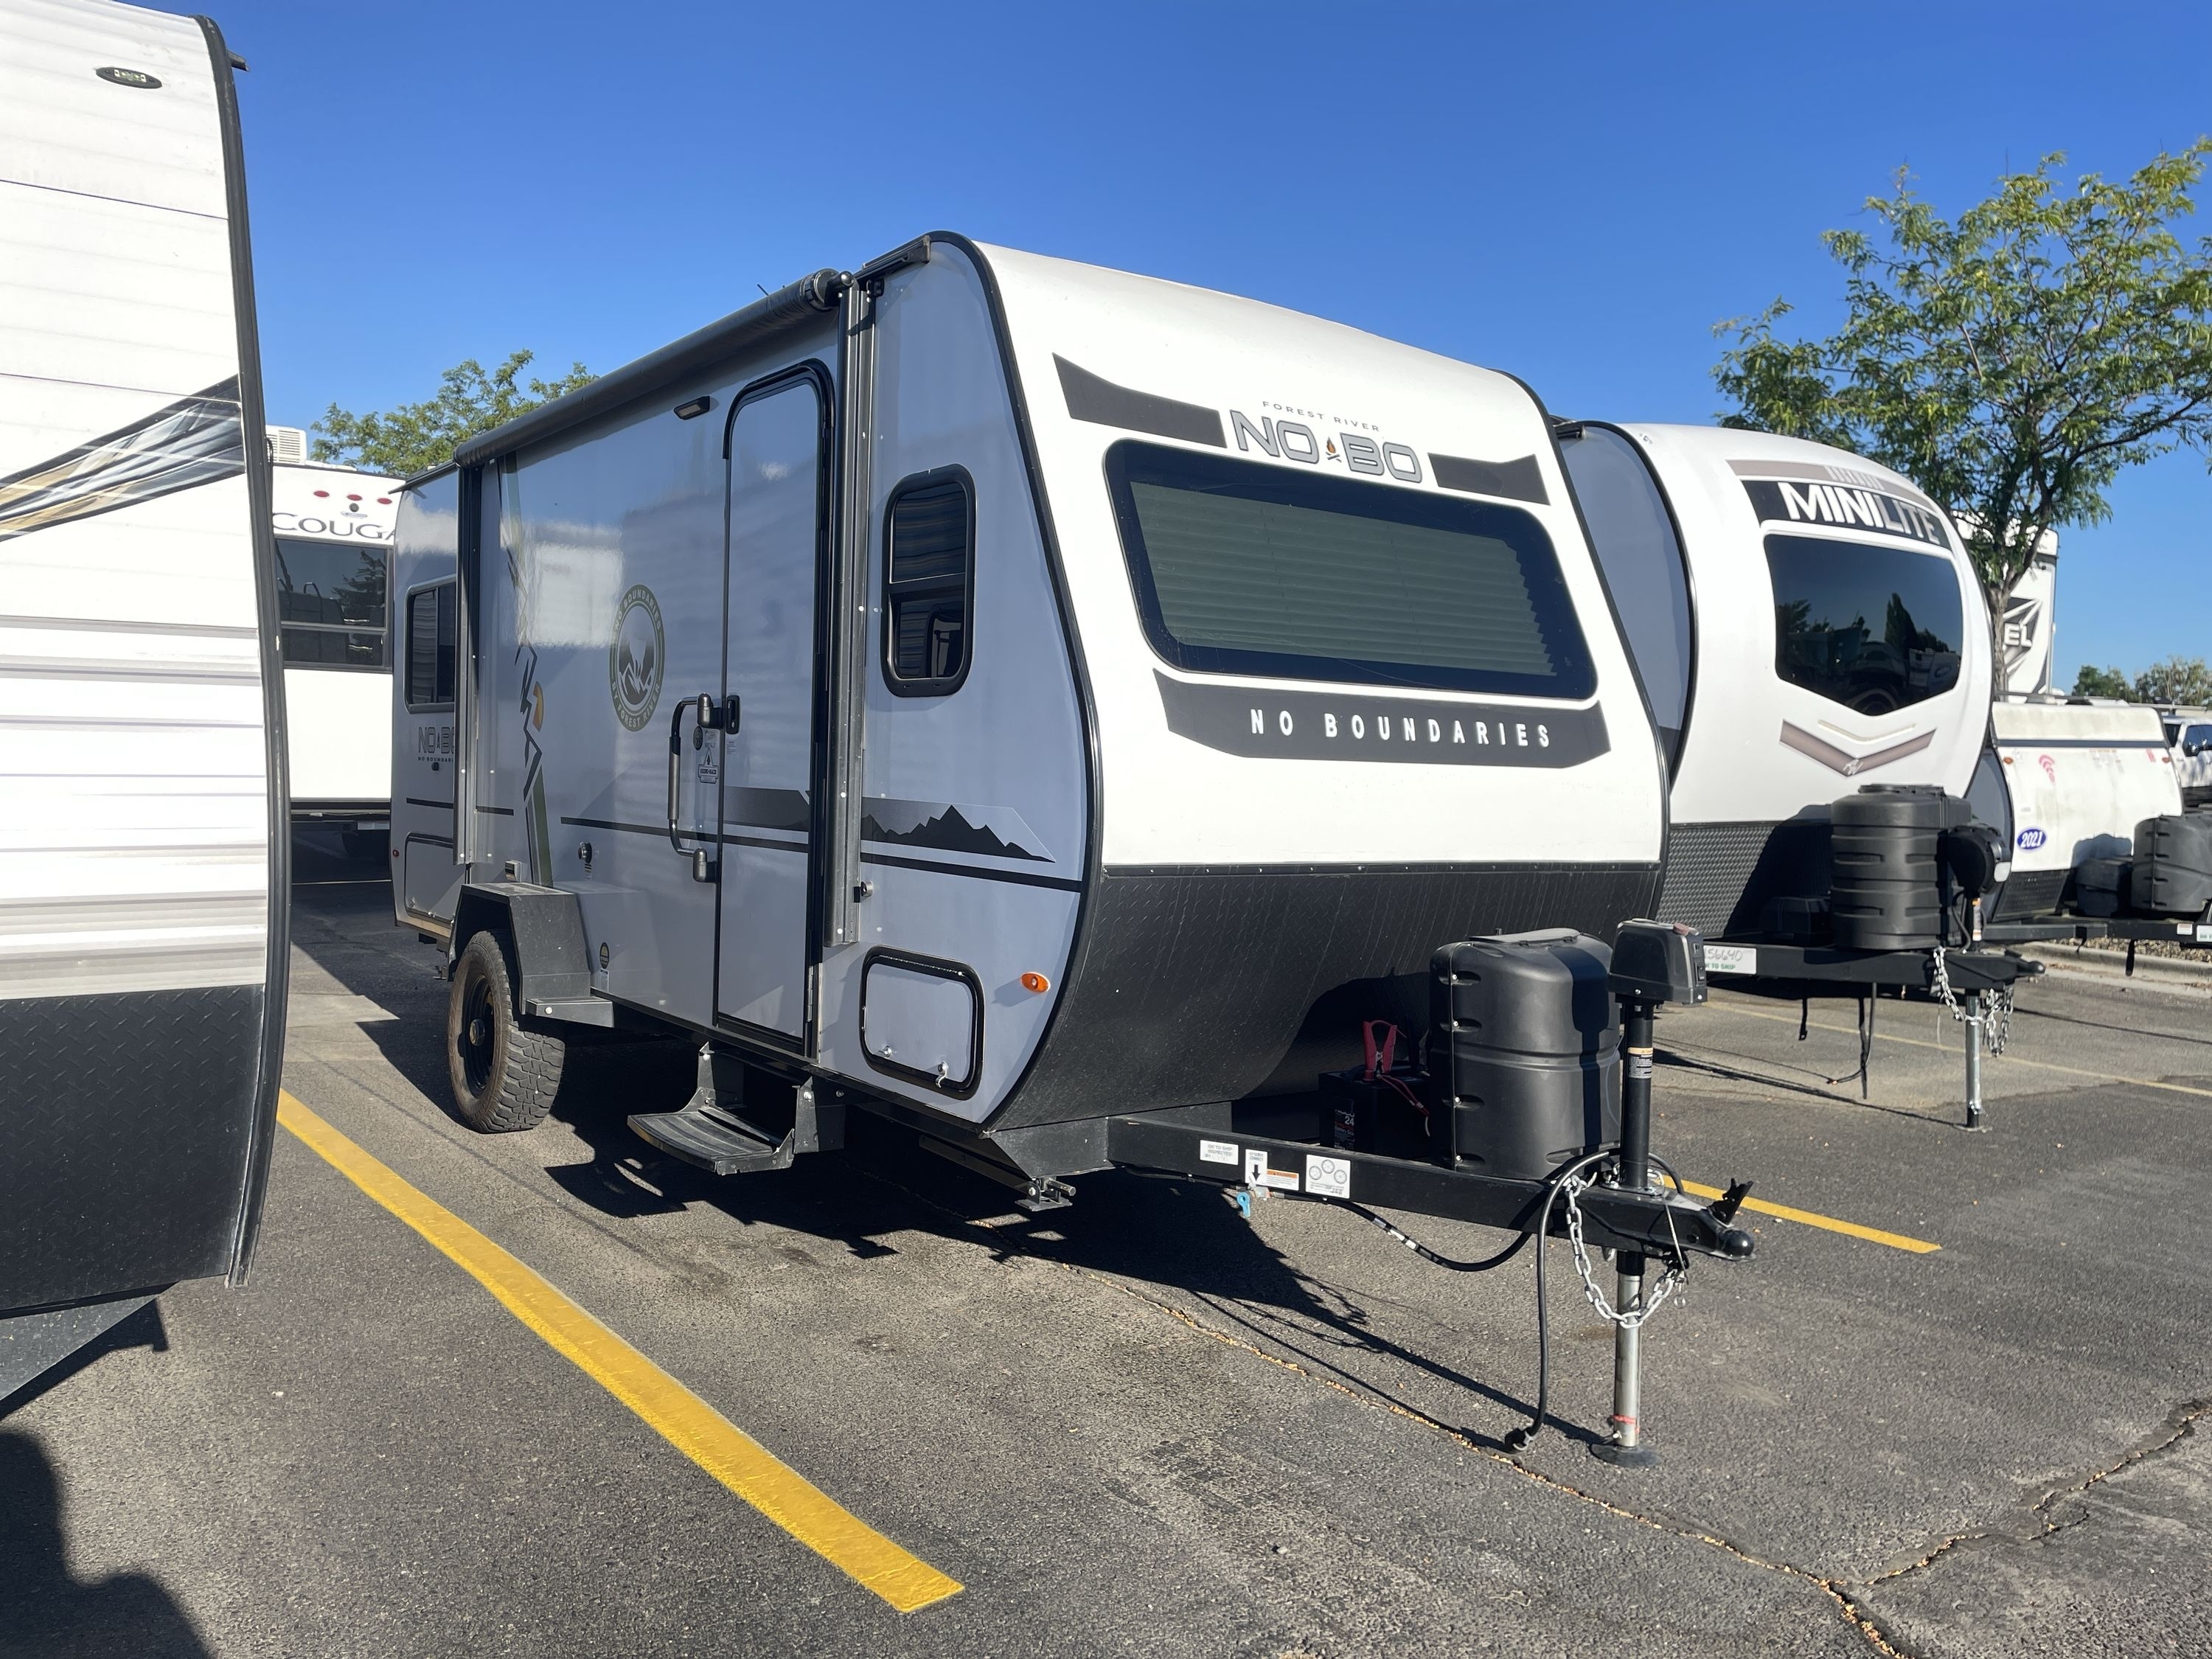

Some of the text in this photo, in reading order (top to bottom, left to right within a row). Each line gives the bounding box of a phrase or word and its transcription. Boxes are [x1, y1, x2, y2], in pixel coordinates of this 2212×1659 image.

[1262, 400, 1380, 432] FOREST RIVER
[624, 589, 662, 630] BOUNDARIES
[612, 683, 661, 728] BY FOREST RIVER
[1250, 709, 1550, 748] NO BOUNDARIES
[2020, 831, 2043, 848] 2021
[1344, 1116, 1355, 1127] 24
